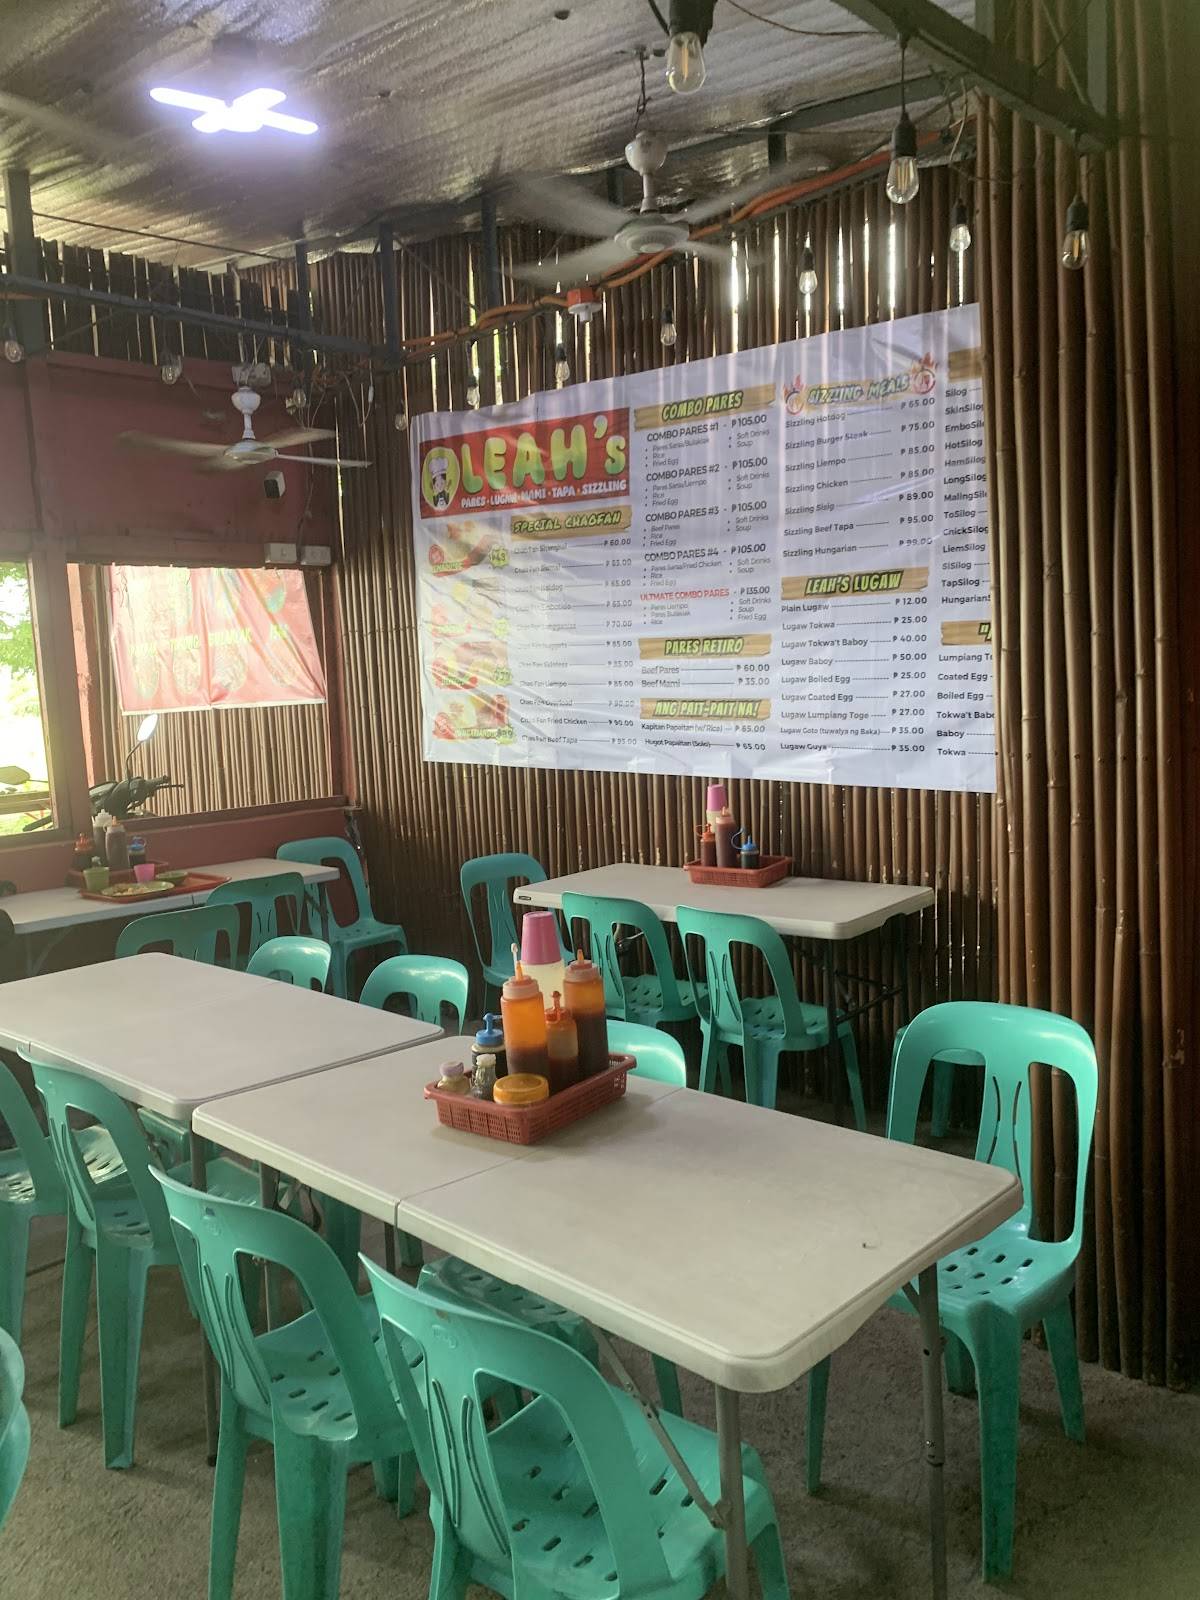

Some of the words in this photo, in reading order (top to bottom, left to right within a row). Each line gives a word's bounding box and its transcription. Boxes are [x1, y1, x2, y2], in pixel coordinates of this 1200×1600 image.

[808, 384, 863, 404] SIZZLING
[867, 374, 909, 400] MEALS
[945, 388, 968, 397] Silog
[662, 399, 703, 421] COMBO
[704, 391, 743, 414] PARES
[785, 416, 815, 428] Sizzling
[647, 430, 678, 441] COMBO
[680, 425, 708, 437] PARES
[785, 439, 815, 450] Sizzling
[817, 435, 843, 447] Burger
[945, 439, 983, 450] HotSilog
[785, 462, 815, 472] Sizzling
[816, 458, 846, 468] Liempo
[945, 455, 986, 467] HamSilog
[646, 470, 677, 481] COMBO
[679, 466, 707, 477] PARES
[709, 464, 719, 472] #2
[552, 486, 575, 498] TAPA
[582, 479, 626, 495] SIZZLING
[785, 484, 815, 494] Sizzling
[816, 479, 848, 489] Chicken
[646, 511, 676, 522] COMBO
[678, 508, 706, 519] PARES
[709, 506, 719, 515] #3
[785, 505, 814, 515] Sizzling
[817, 503, 835, 513] Sisig
[944, 509, 976, 519] ToSilog
[514, 518, 560, 533] SPECIAL
[565, 511, 621, 529] CHAOFAN
[783, 526, 813, 537] Sizzling
[815, 524, 831, 533] Beef
[834, 523, 854, 532] Tapa
[783, 548, 813, 558] Sizzling
[815, 545, 857, 556] Hungarian
[943, 544, 986, 553] LiemSilog
[645, 551, 676, 562] COMBO
[677, 548, 705, 559] PARES
[942, 562, 972, 571] SiSilog
[805, 574, 850, 594] LEAH'S
[853, 572, 902, 592] LUGAW
[941, 578, 980, 588] TapSilog
[675, 590, 703, 600] COMBO
[704, 589, 730, 597] PARES
[802, 604, 830, 612] Lugaw
[782, 623, 807, 631] Lugaw
[809, 621, 835, 629] Tokwa
[665, 639, 700, 655] PARES
[702, 638, 744, 654] RETIRO
[781, 641, 807, 649] Lugaw
[809, 639, 840, 647] Tokwa't
[842, 638, 868, 648] Baboy
[781, 658, 807, 666] Lugaw
[808, 658, 833, 666] Baboy
[938, 653, 982, 662] Lumpiang
[642, 666, 658, 674] Beef
[660, 666, 679, 674] Pares
[781, 676, 807, 684] Lugaw
[808, 675, 833, 683] Boiled
[835, 676, 851, 684] Egg
[938, 672, 968, 680] Coated
[971, 673, 988, 682] Egg
[781, 693, 807, 702] Lugaw
[808, 693, 836, 701] Coated
[838, 693, 853, 702] Egg
[937, 692, 965, 700] Boiled
[967, 692, 984, 700] Egg
[654, 701, 678, 716] ANG
[680, 701, 736, 717] PAIT-PAIT
[737, 701, 760, 718] NA!
[936, 711, 972, 719] Tokwa't
[781, 712, 807, 720] Lugaw
[808, 711, 847, 720] Lumpiang
[850, 712, 869, 720] Toge
[936, 729, 965, 738] Baboy
[937, 748, 966, 756] Tokwa
